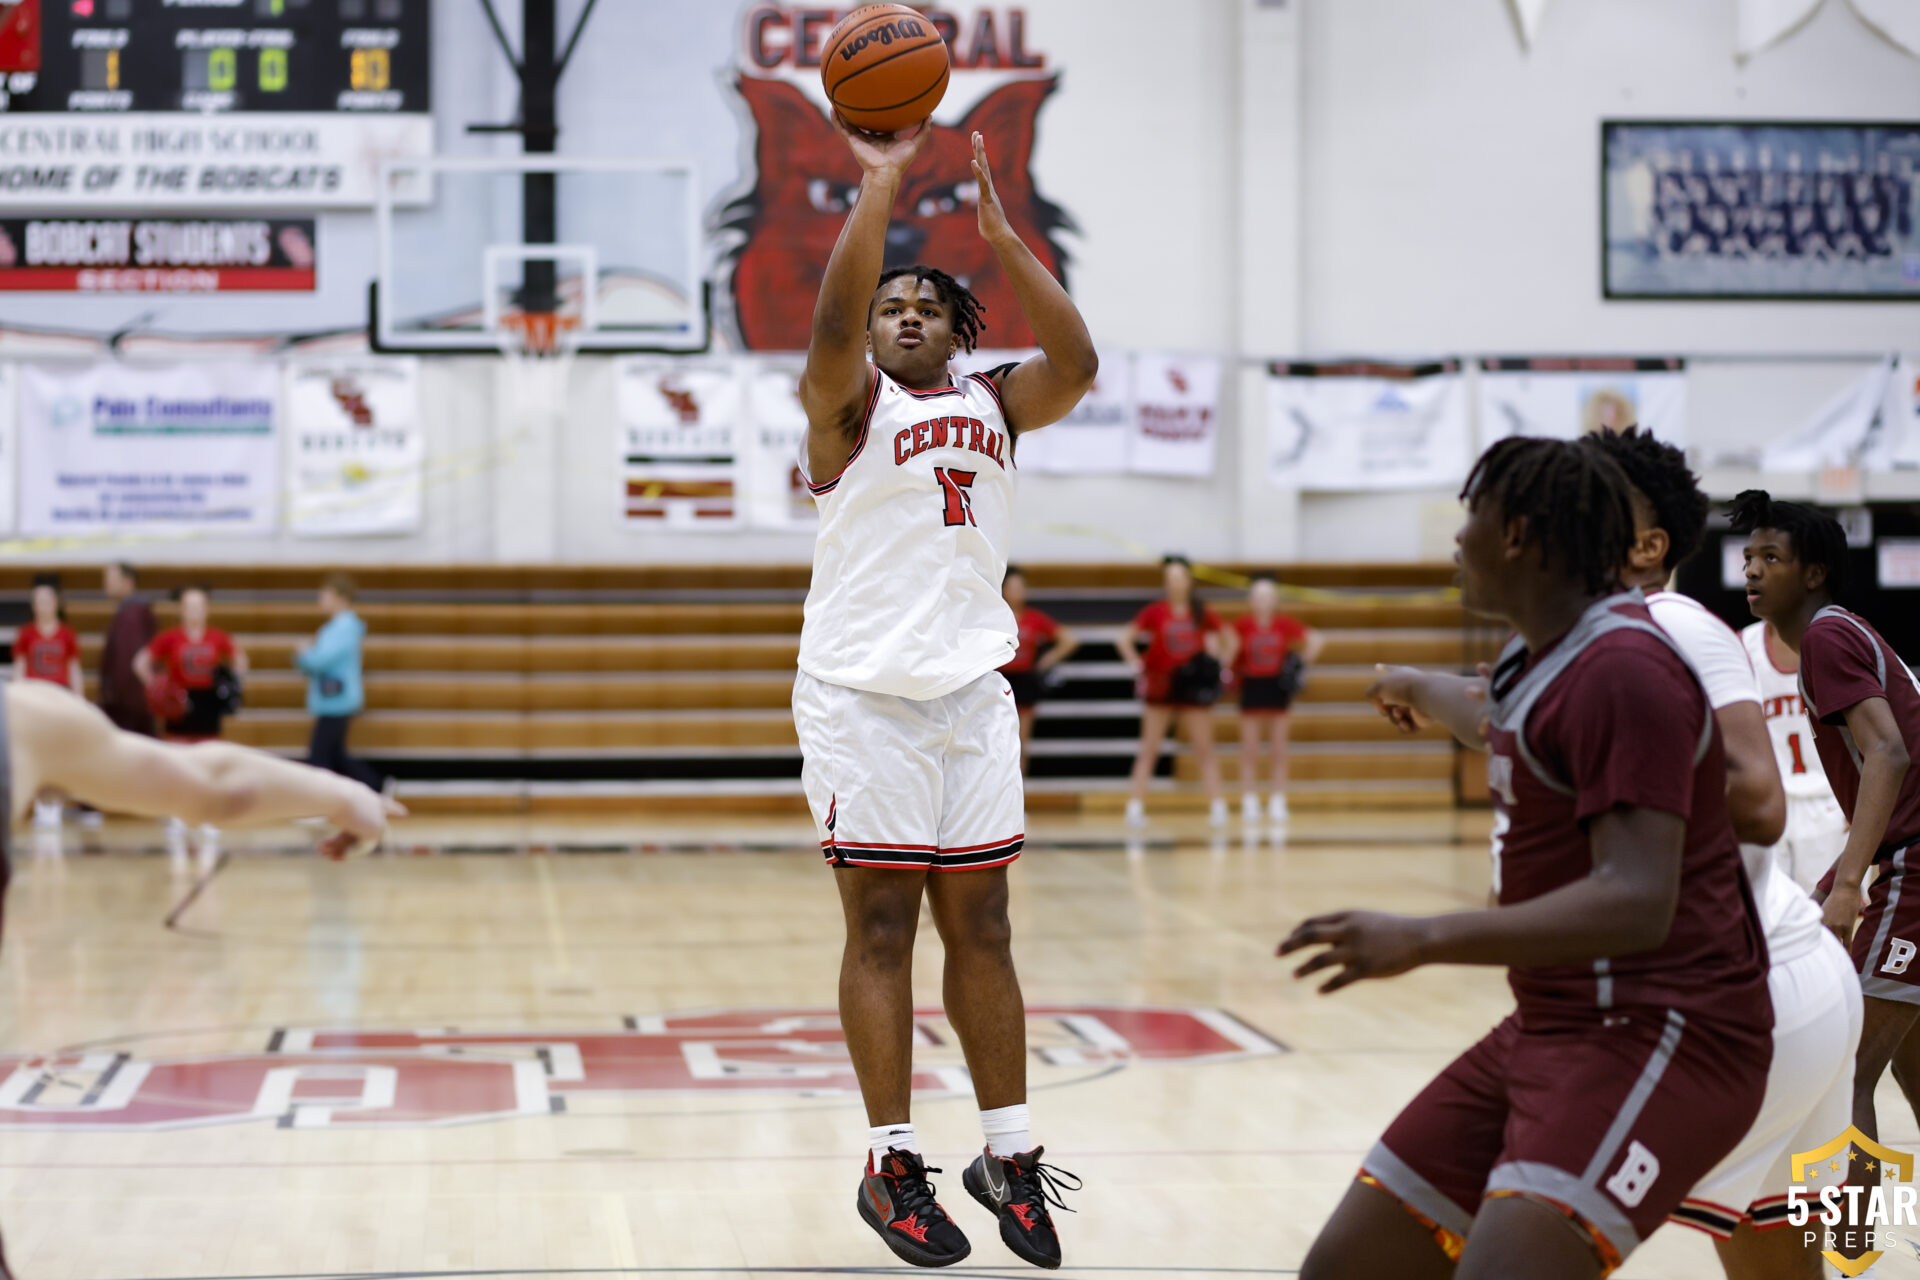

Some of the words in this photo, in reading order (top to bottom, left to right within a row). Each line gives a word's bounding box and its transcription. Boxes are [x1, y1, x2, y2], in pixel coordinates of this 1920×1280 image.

[750, 6, 1044, 69] CERAL
[840, 20, 927, 61] Wilson
[0, 126, 121, 153] CENTRAL
[131, 126, 203, 155] HIGH
[208, 126, 320, 153] SCHOOL
[83, 164, 121, 191] OF
[134, 164, 190, 191] THE
[199, 163, 342, 193] BOBCATS
[25, 221, 130, 265] BOBCAT
[134, 221, 270, 265] STUDENTS
[77, 268, 218, 289] SECTION
[894, 416, 1005, 471] CENTRAL
[1788, 733, 1806, 774] 1
[1880, 937, 1917, 975] B
[1605, 1139, 1660, 1208] B
